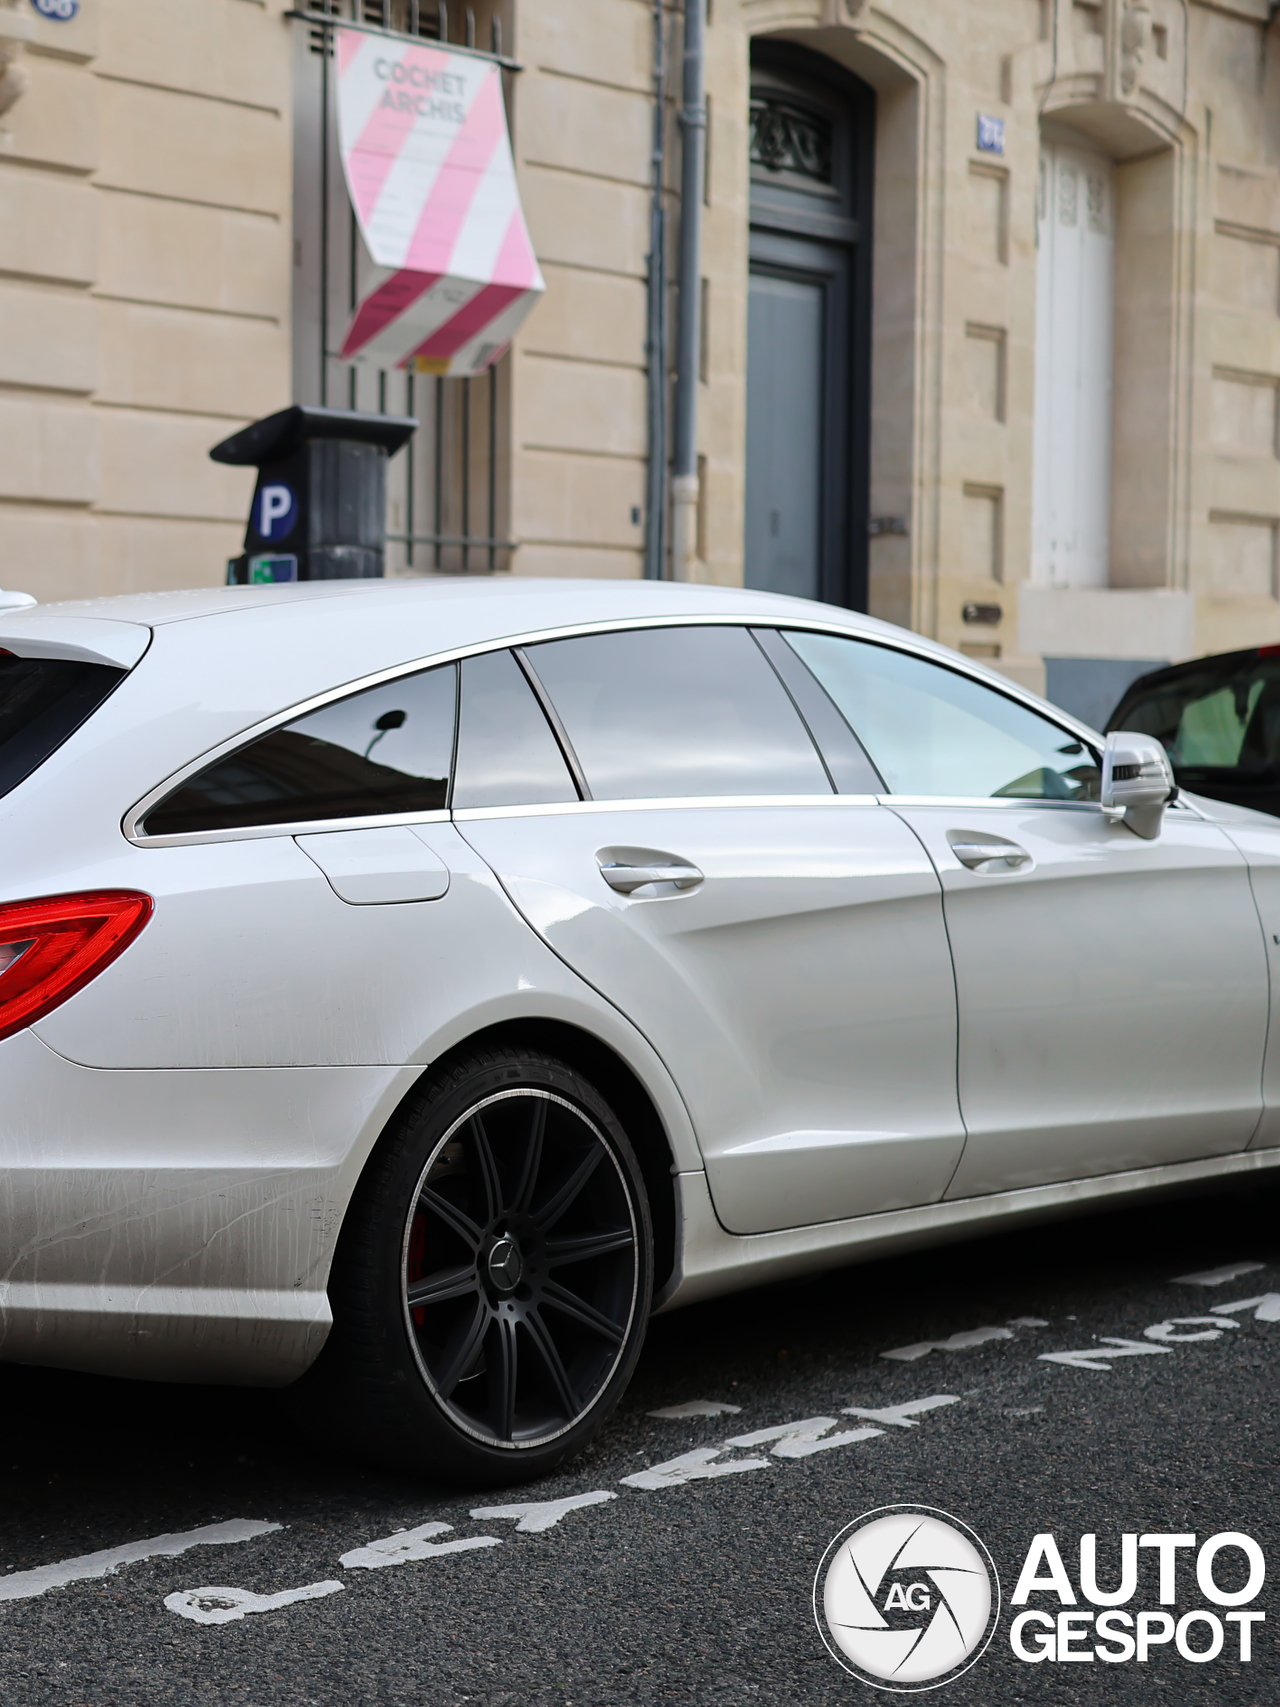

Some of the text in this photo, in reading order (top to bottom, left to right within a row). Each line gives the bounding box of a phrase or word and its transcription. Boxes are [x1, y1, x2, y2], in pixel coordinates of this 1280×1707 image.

[373, 58, 467, 97] COCHET
[380, 88, 467, 124] ARCHIS
[260, 485, 292, 537] P
